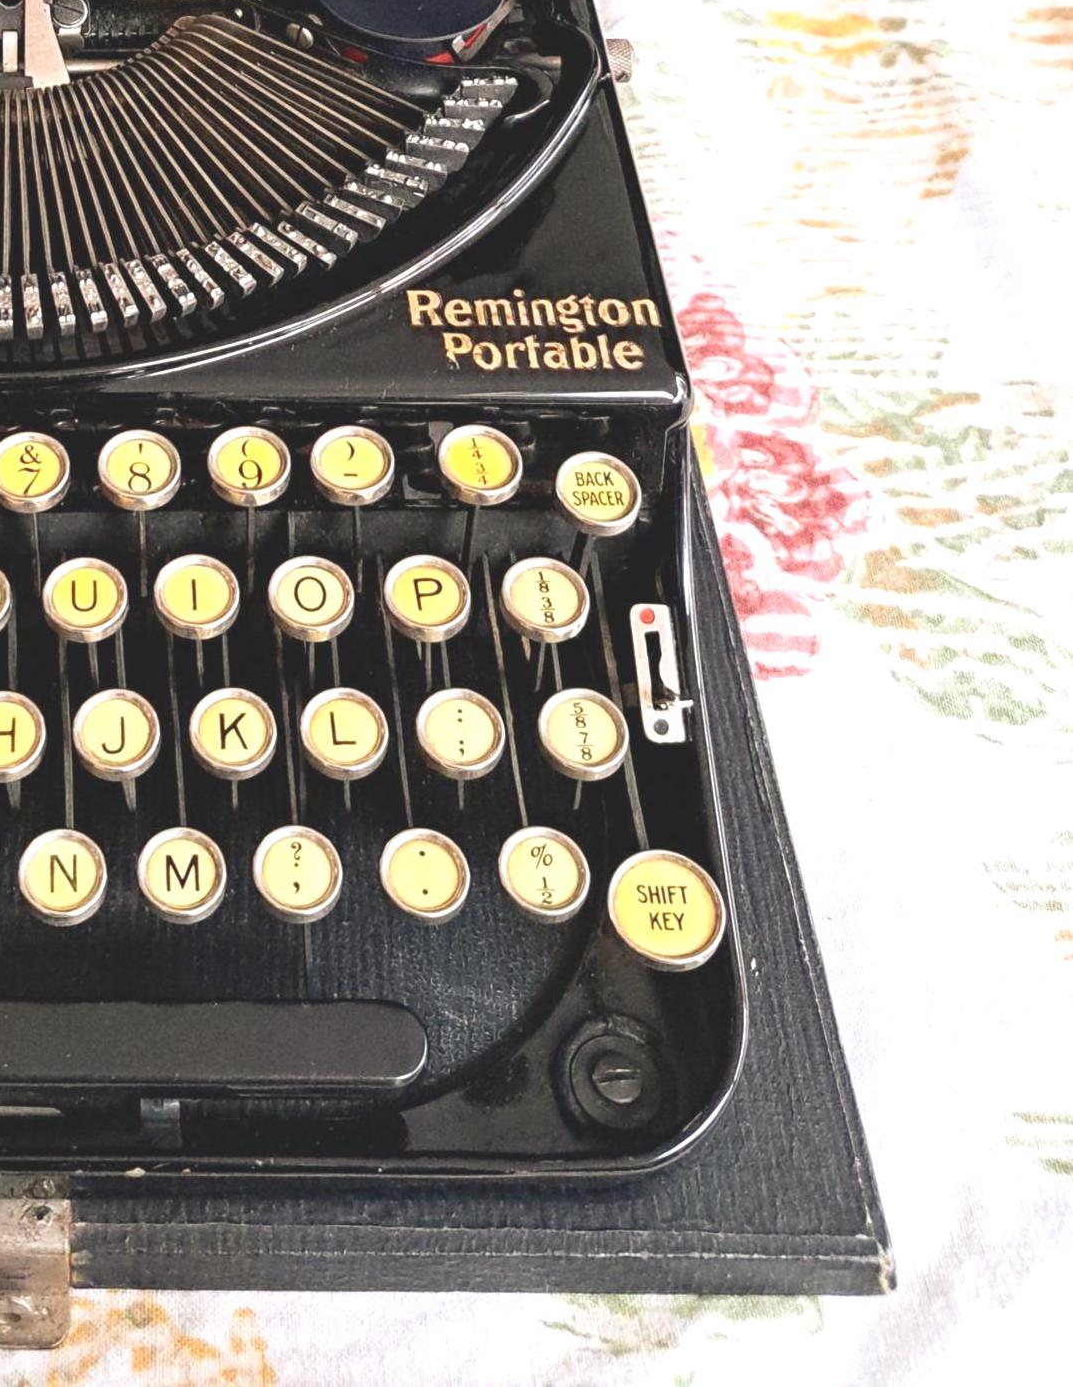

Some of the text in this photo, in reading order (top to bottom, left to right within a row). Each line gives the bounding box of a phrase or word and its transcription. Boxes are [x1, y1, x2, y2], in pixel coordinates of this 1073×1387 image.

[406, 288, 662, 333] Remington
[442, 331, 645, 371] Portable
[20, 443, 44, 465] &
[18, 467, 45, 498] 7
[127, 463, 153, 494] 8
[237, 459, 262, 490] 9
[573, 470, 615, 488] BACK
[572, 491, 625, 507] SPACER
[71, 580, 98, 613] U
[294, 575, 327, 612] O
[413, 577, 443, 611] P
[101, 716, 126, 755] J
[219, 712, 248, 750] K
[329, 711, 357, 746] L
[290, 842, 303, 868] ?
[530, 843, 553, 867] %
[49, 854, 78, 893] N
[165, 854, 200, 892] M
[636, 884, 687, 904] SHIFT
[649, 912, 685, 931] KEY
